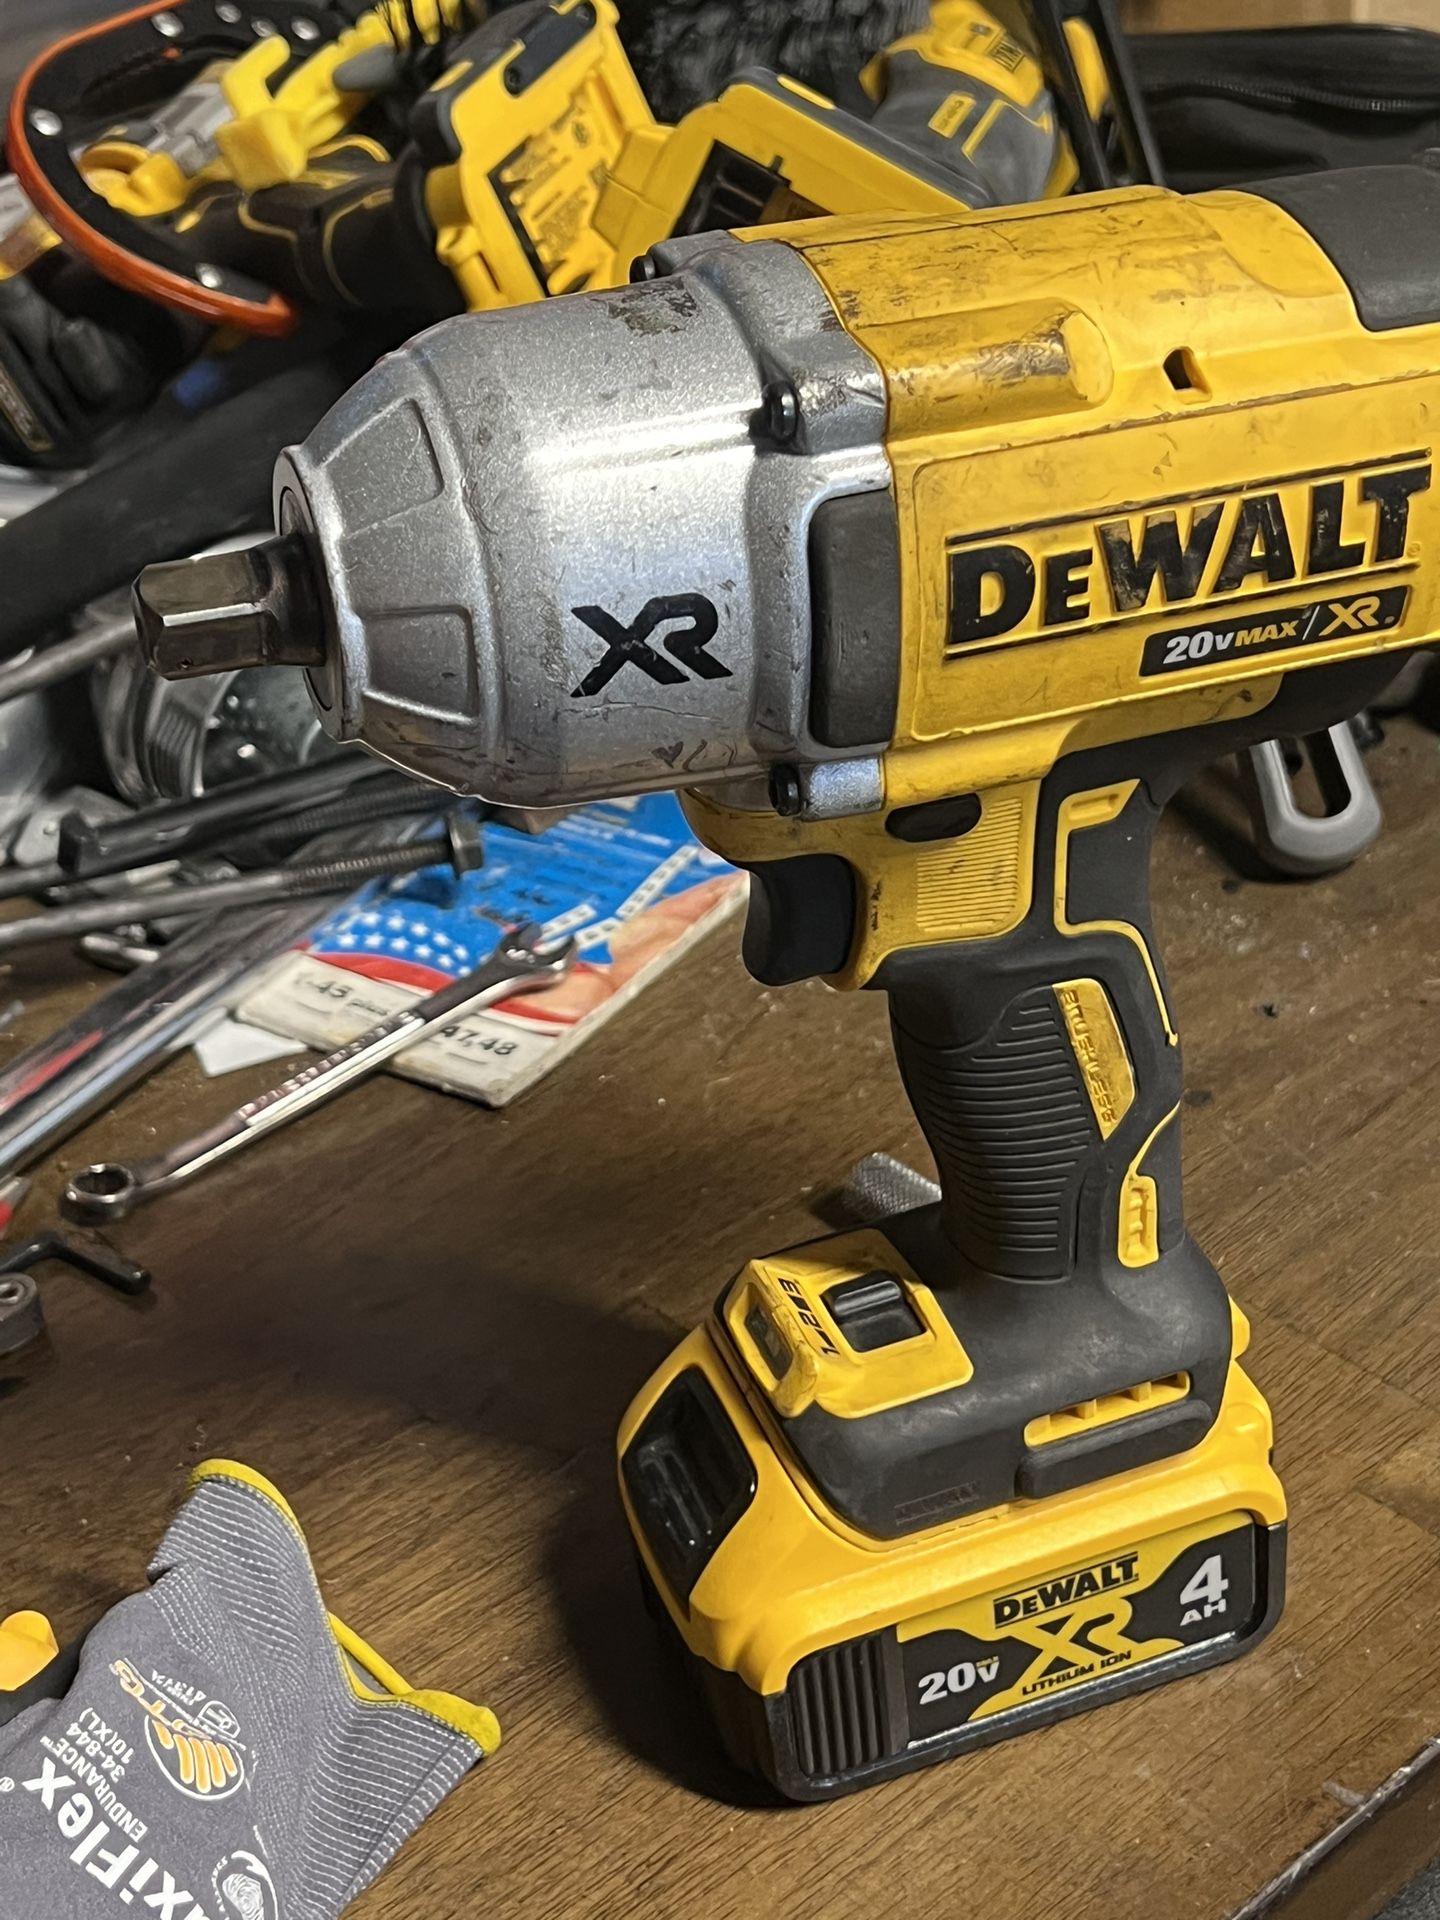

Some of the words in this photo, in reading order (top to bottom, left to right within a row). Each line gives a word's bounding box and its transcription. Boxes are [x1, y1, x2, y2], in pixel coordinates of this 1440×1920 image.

[570, 592, 734, 698] XR
[993, 1553, 1138, 1627] DEWALT
[1179, 1555, 1229, 1606] 4
[1021, 1662, 1095, 1696] LITHIUM
[1100, 1650, 1132, 1671] ION
[66, 1722, 125, 1783] 34-844
[79, 1707, 134, 1764] 10(XL)
